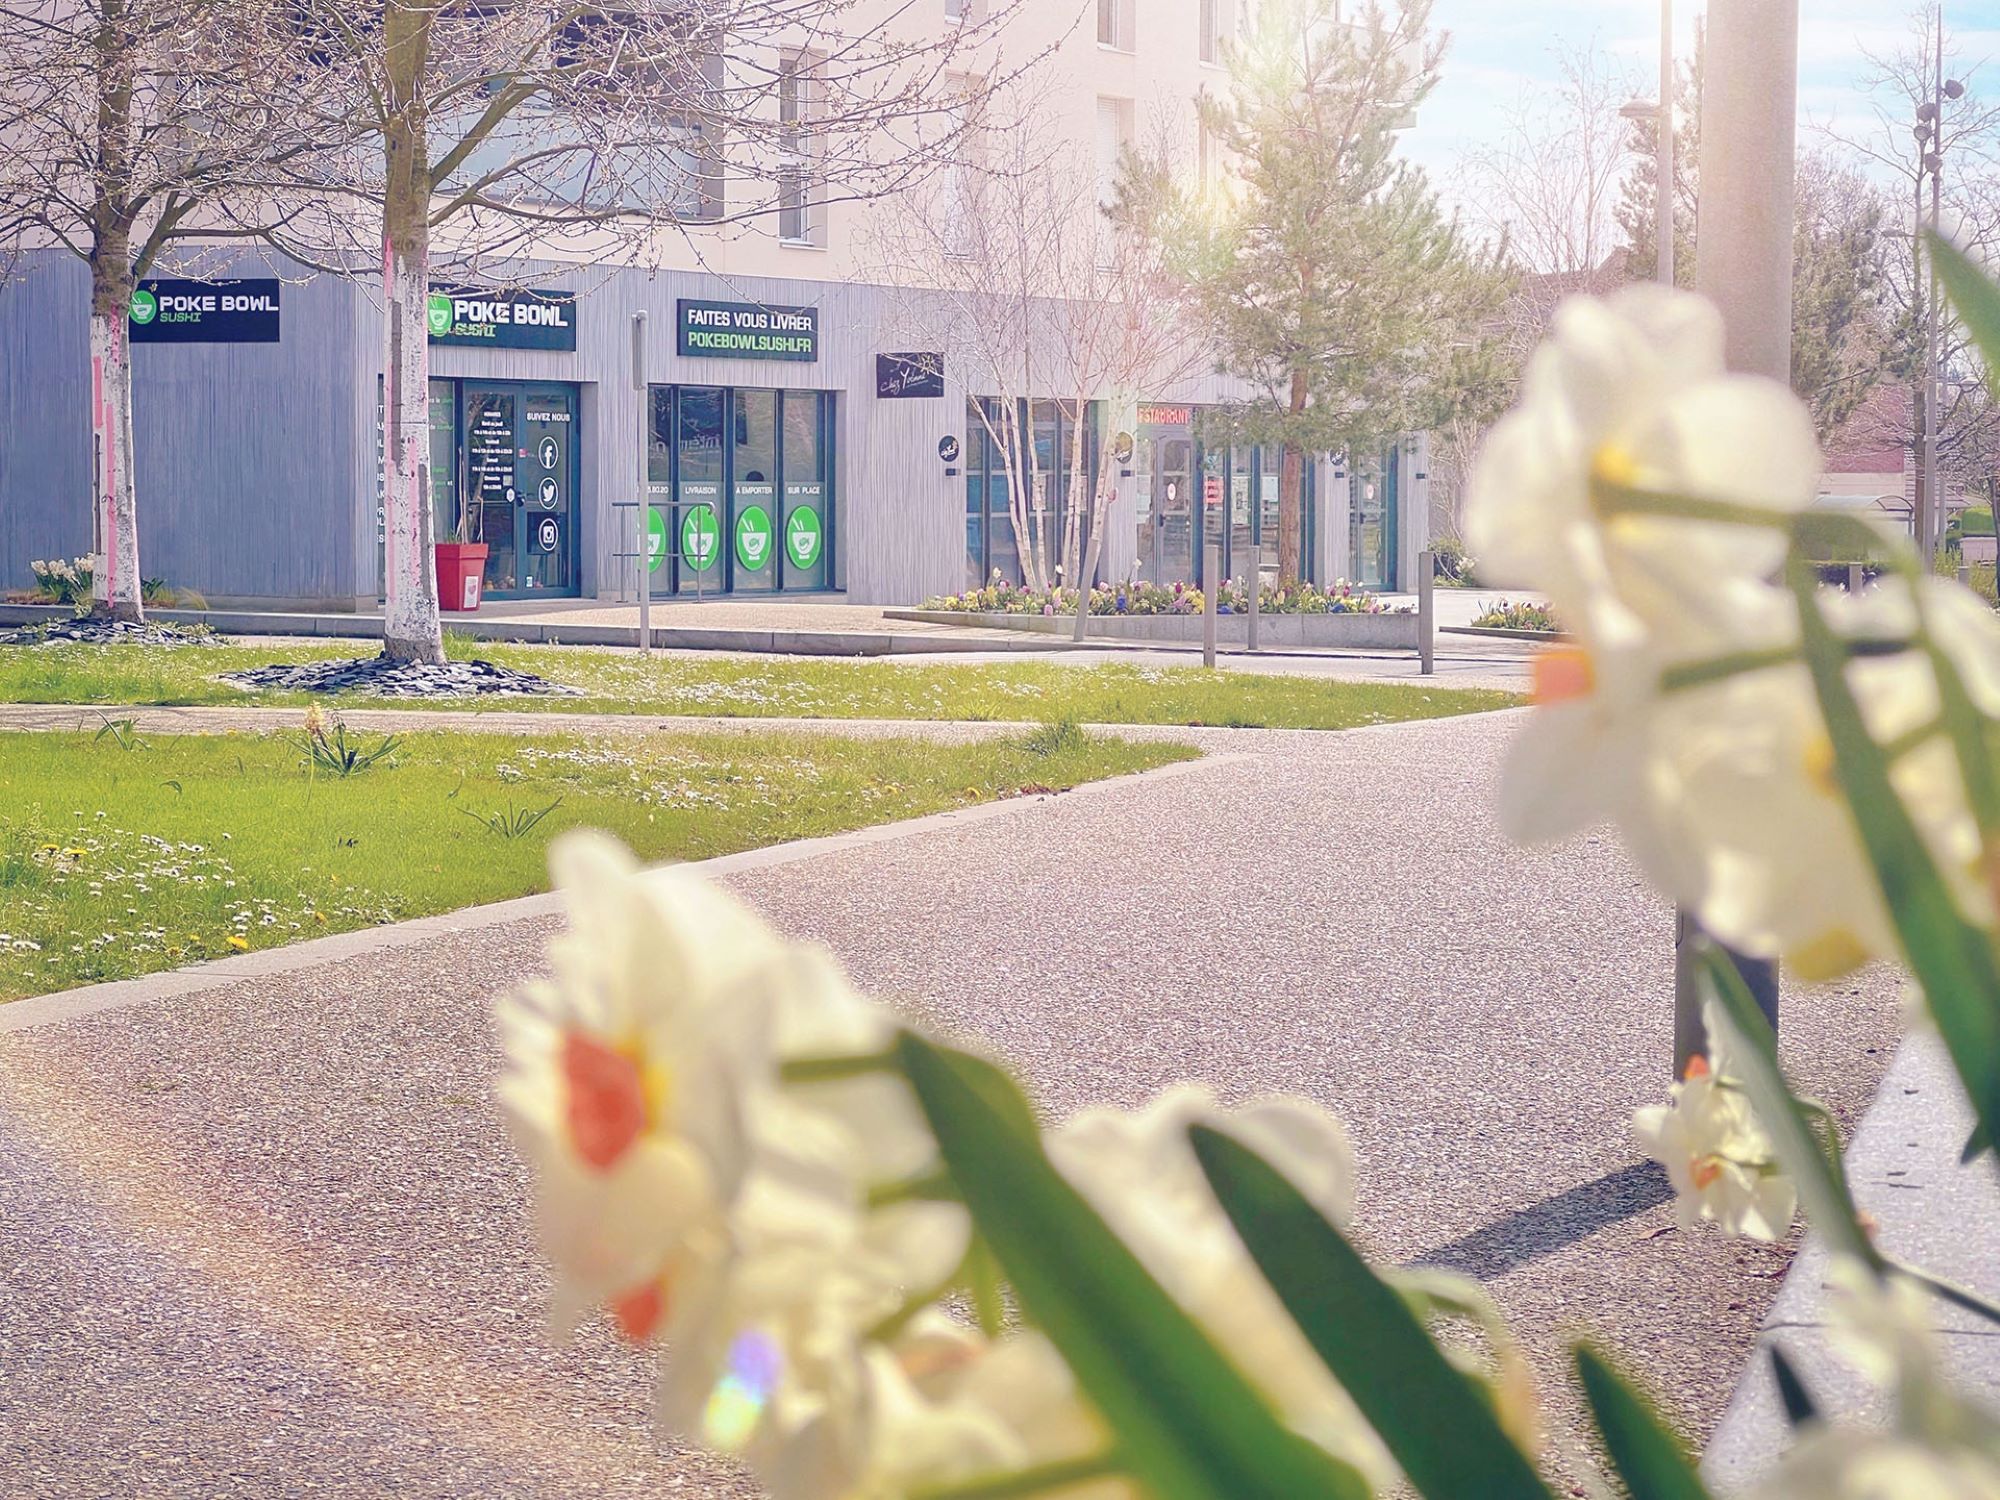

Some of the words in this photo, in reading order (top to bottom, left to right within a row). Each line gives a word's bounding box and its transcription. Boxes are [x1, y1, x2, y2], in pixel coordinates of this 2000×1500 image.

[159, 295, 216, 312] POKE
[221, 295, 280, 312] BOWL
[159, 312, 202, 323] SUSHI
[454, 300, 510, 324] POKE
[513, 303, 568, 327] BOWL
[687, 309, 730, 327] FAITES
[733, 311, 768, 329] VOUS
[770, 313, 813, 331] LIVRER
[454, 322, 497, 338] SUSHI
[526, 412, 551, 422] SUIVEZ
[551, 412, 571, 422] NOUS
[1137, 407, 1189, 425] ESTAURANT
[684, 486, 717, 495] LIVRAISON
[742, 486, 773, 495] EMPORTER
[787, 486, 801, 495] SUR
[802, 486, 821, 495] PLACE
